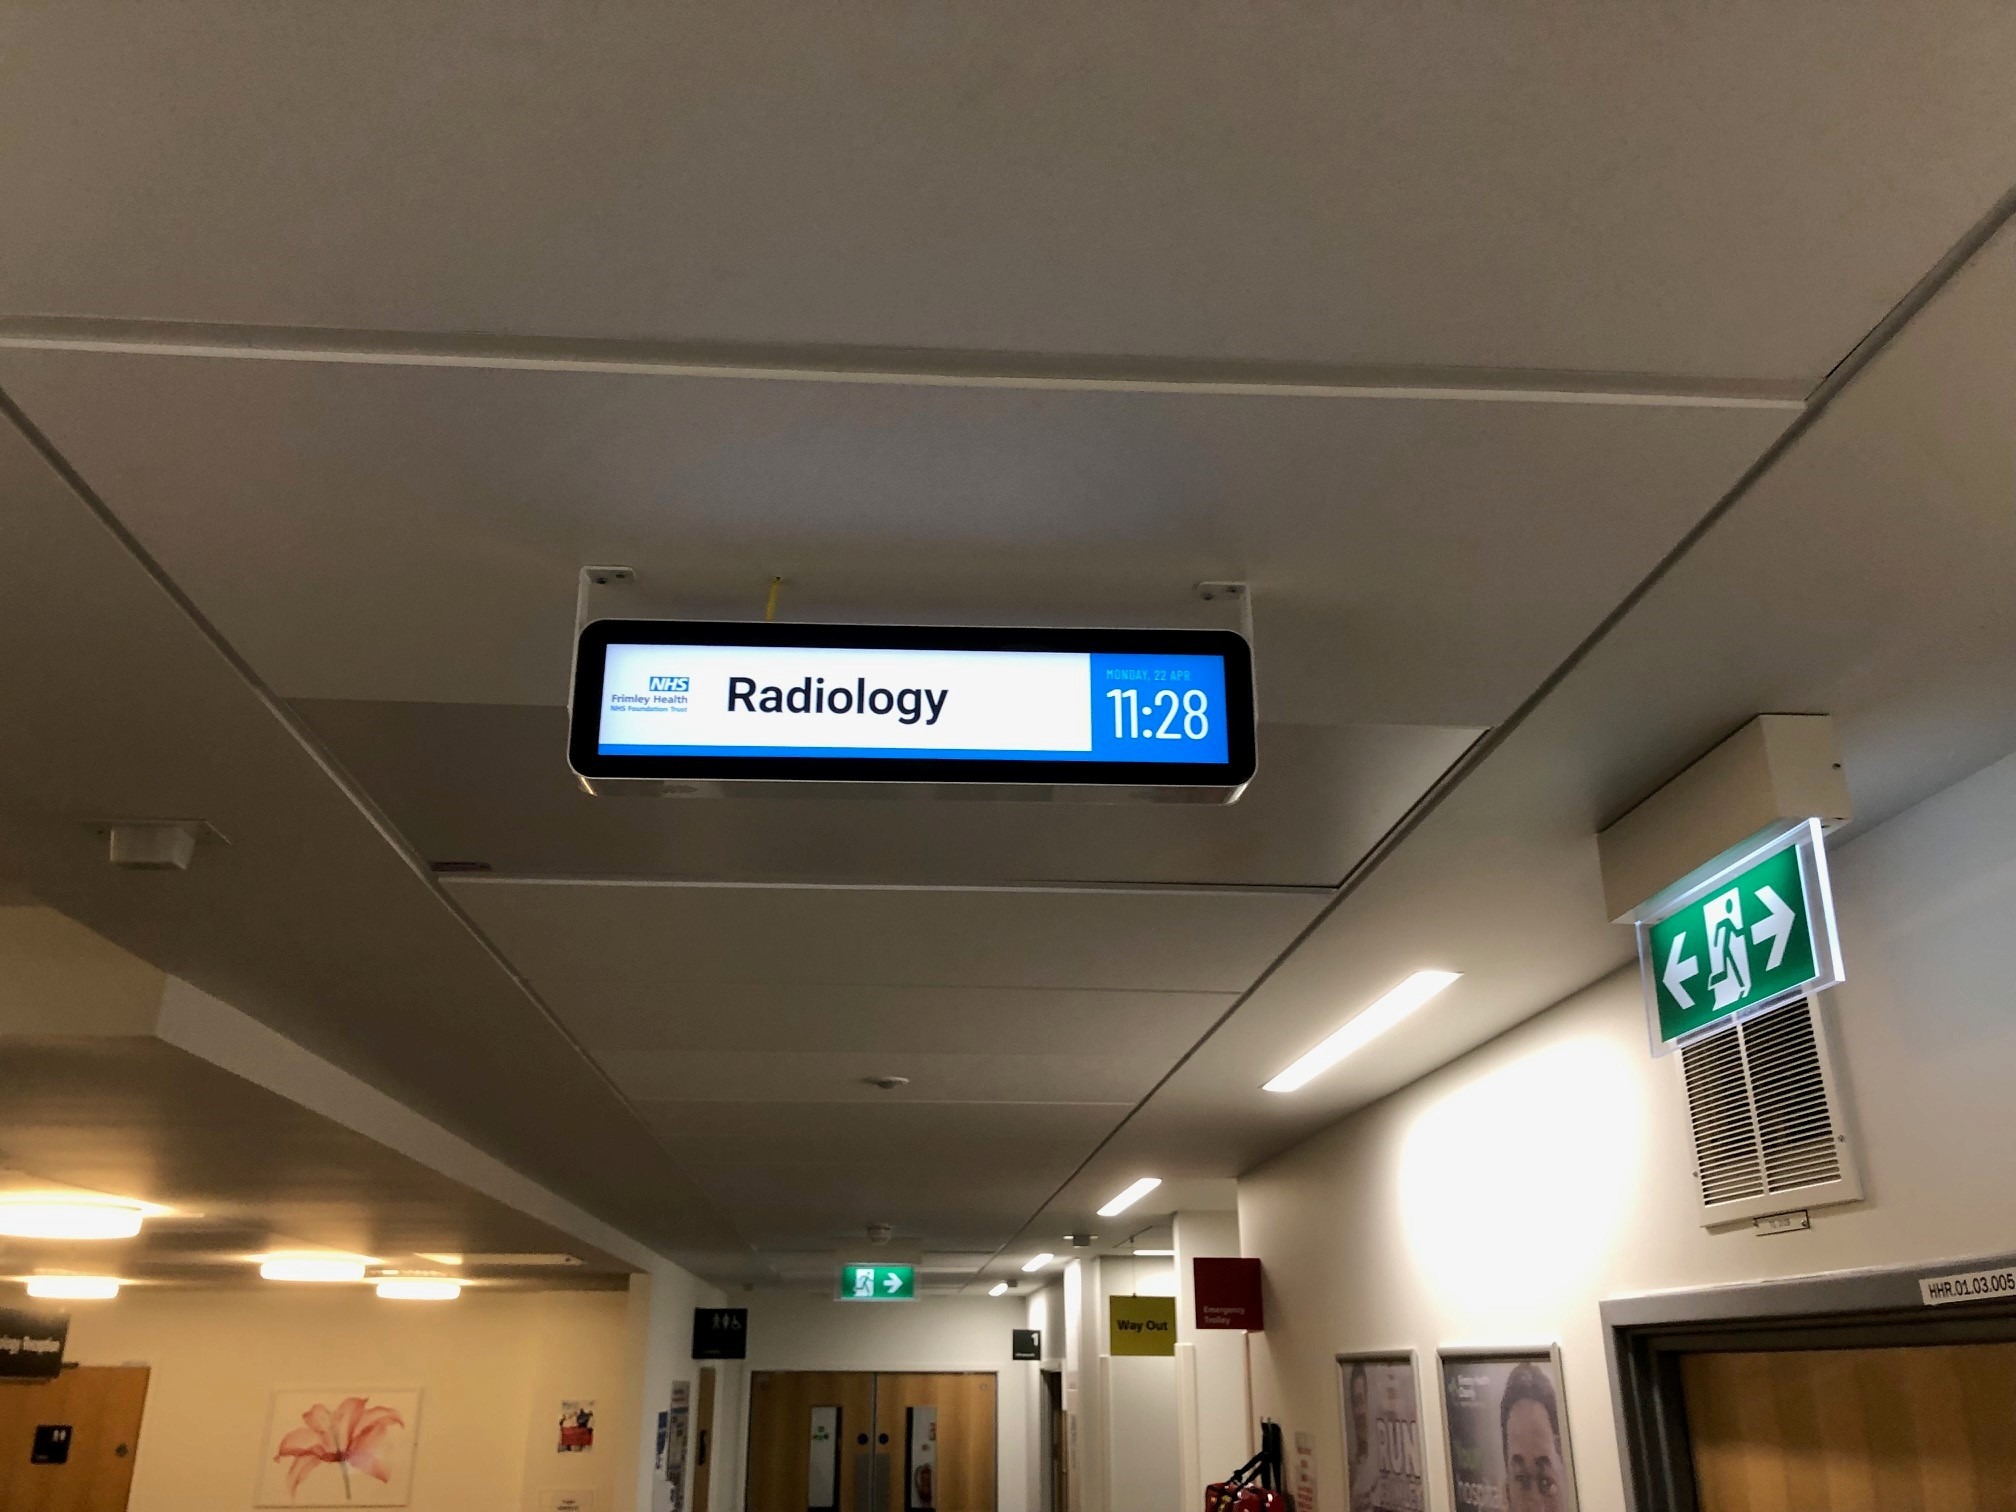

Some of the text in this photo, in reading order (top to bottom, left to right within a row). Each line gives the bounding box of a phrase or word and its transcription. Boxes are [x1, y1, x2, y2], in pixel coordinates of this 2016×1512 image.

[1106, 669, 1191, 681] MONDAY, 22 APR
[650, 677, 688, 691] NHS
[611, 694, 688, 705] Frimley Health
[727, 676, 949, 725] Radiology
[1106, 688, 1209, 740] 11:28
[1928, 1273, 2015, 1299] HHR.01.03.005
[1203, 1305, 1246, 1315] Emergency
[1117, 1320, 1168, 1333] Way Out
[1204, 1315, 1231, 1325] Trolley
[1031, 1332, 1039, 1346] 1
[1375, 1417, 1422, 1480] RUN
